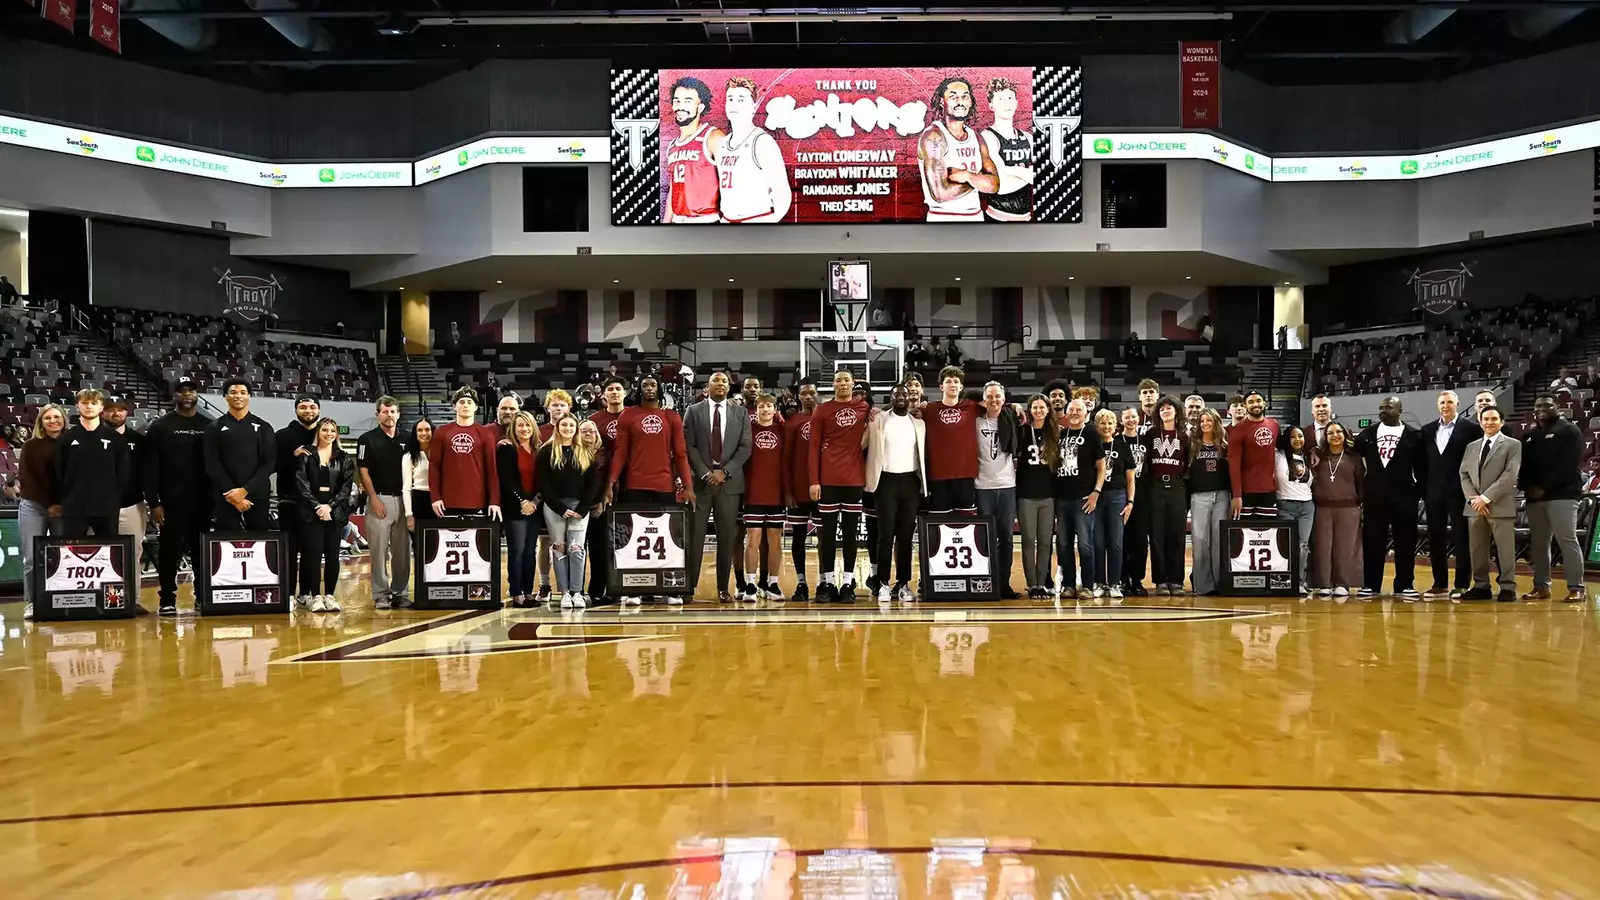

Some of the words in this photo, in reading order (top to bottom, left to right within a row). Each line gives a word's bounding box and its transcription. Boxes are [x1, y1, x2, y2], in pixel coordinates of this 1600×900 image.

[815, 79, 852, 90] THANK
[854, 79, 878, 90] YOU
[66, 138, 99, 149] SunSouth
[1116, 142, 1147, 151] JOHN
[1149, 141, 1187, 150] DEERE
[1529, 139, 1562, 150] SunSouth
[490, 146, 526, 155] DEERE
[796, 152, 832, 163] TAYTON
[833, 149, 896, 163] CONERWAY
[160, 153, 191, 166] JOHN
[192, 158, 229, 173] DEERE
[720, 156, 740, 166] TROY
[1423, 159, 1454, 170] JOHN
[1455, 151, 1494, 165] DEERE
[259, 171, 287, 179] SunSouth
[339, 170, 367, 180] JOHN
[368, 170, 402, 179] DEERE
[673, 163, 686, 183] 12
[794, 168, 837, 179] BRAYDON
[838, 166, 898, 179] WHITAKER
[1273, 166, 1308, 174] DEERE
[721, 171, 733, 189] 21
[802, 185, 854, 195] RANDARIUS
[854, 183, 890, 195] JONES
[819, 201, 844, 212] THEO
[844, 199, 874, 212] SENG
[233, 286, 269, 306] TROY
[1421, 279, 1458, 300] TROY
[233, 305, 269, 315] TROJANS
[1421, 299, 1457, 309] TROJANS
[339, 426, 348, 434] EXIT
[1104, 450, 1119, 459] EO
[1379, 447, 1395, 460] RO
[1057, 467, 1079, 477] SENG
[1205, 459, 1217, 472] 12
[636, 536, 666, 560] 24
[232, 551, 254, 559] BRYANT
[944, 546, 973, 569] 33
[1248, 548, 1272, 571] 12
[446, 550, 471, 575] 21
[66, 566, 105, 579] TROY
[240, 561, 247, 580] 1
